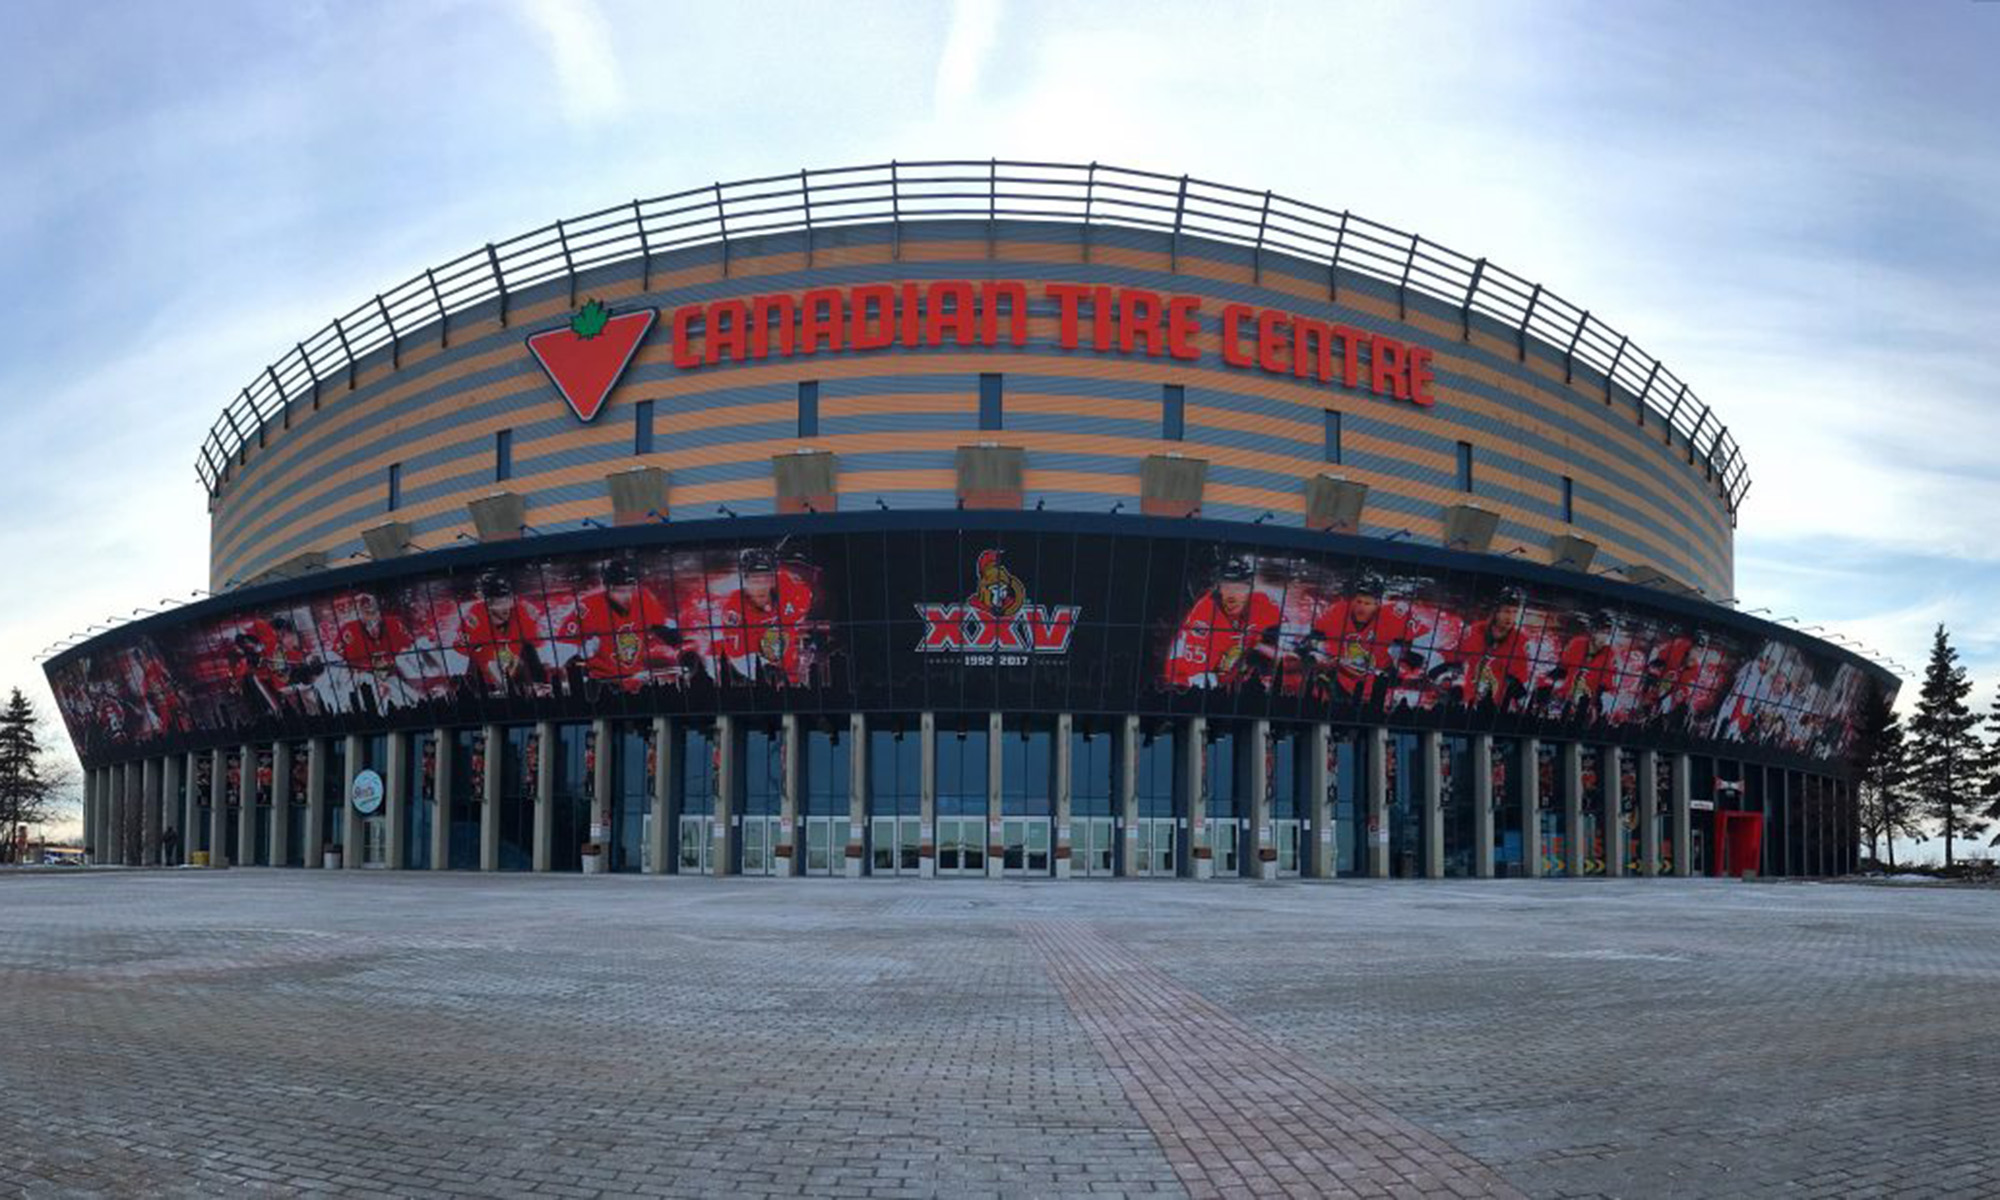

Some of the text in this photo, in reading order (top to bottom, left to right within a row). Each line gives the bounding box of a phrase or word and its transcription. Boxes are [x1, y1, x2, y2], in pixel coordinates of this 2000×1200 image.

[672, 280, 1436, 407] CANADIAN TIRE CENTRE
[914, 602, 1082, 654] XXV
[964, 655, 1029, 666] 1992 2017
